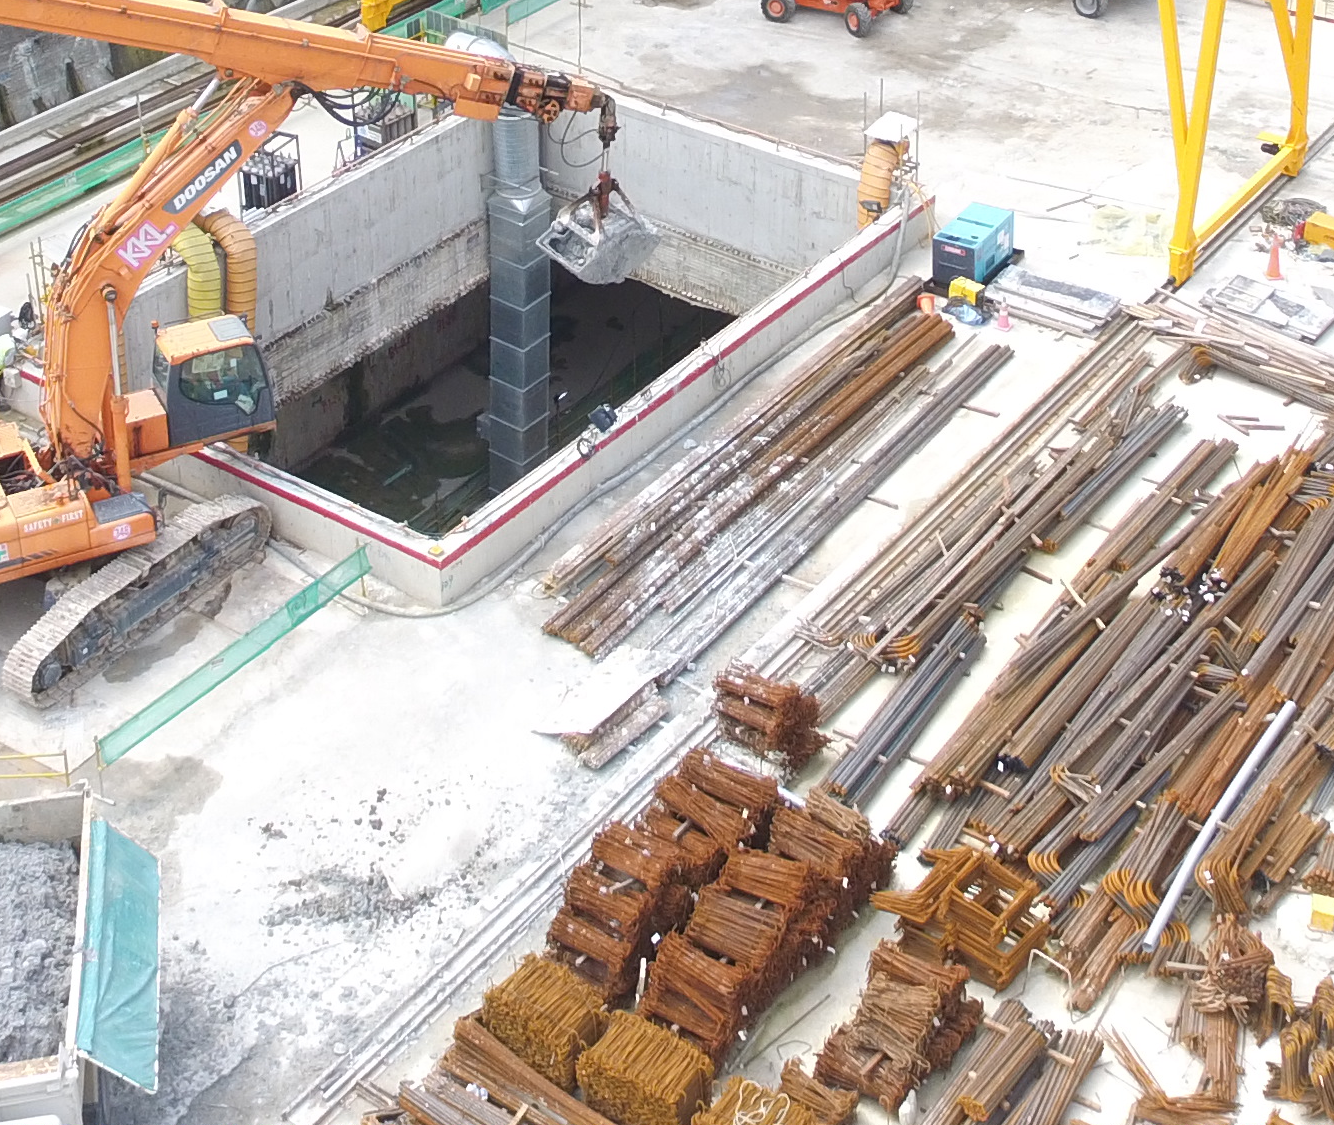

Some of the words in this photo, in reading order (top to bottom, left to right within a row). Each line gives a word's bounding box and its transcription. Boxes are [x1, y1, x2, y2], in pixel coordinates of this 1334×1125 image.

[172, 146, 238, 211] DOOSAN
[118, 221, 177, 268] KKL
[23, 518, 53, 533] SAFETY
[61, 510, 84, 524] FIRST
